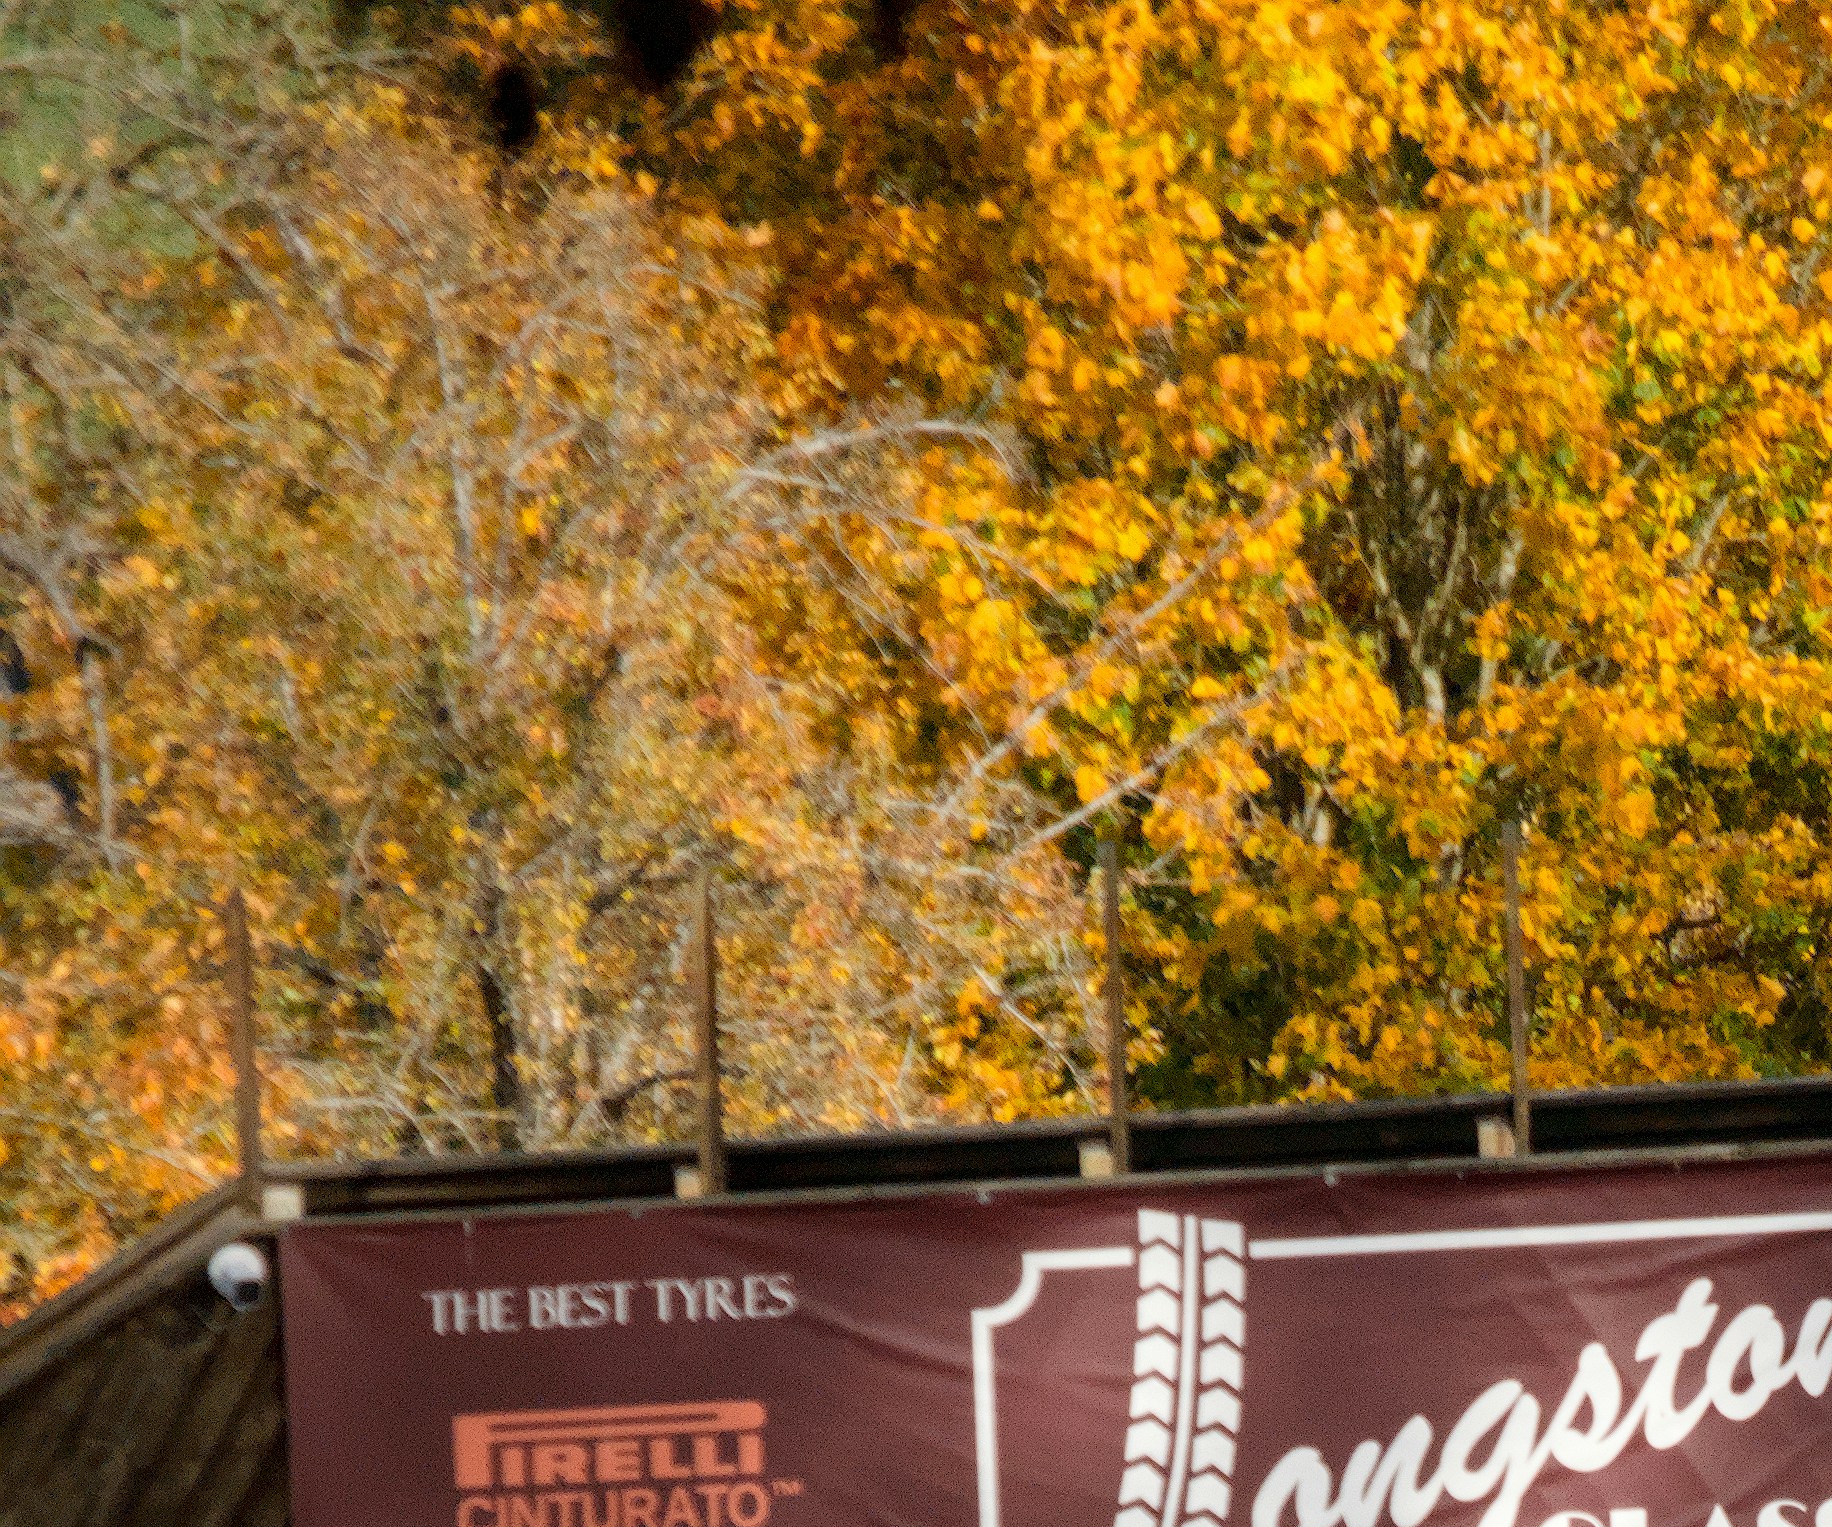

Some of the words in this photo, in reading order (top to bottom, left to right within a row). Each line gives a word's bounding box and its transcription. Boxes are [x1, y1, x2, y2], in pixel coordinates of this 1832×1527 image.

[422, 1287, 521, 1337] THE
[528, 1279, 639, 1330] BEST
[644, 1273, 798, 1323] TYRES
[452, 1399, 767, 1490] PIRELLI
